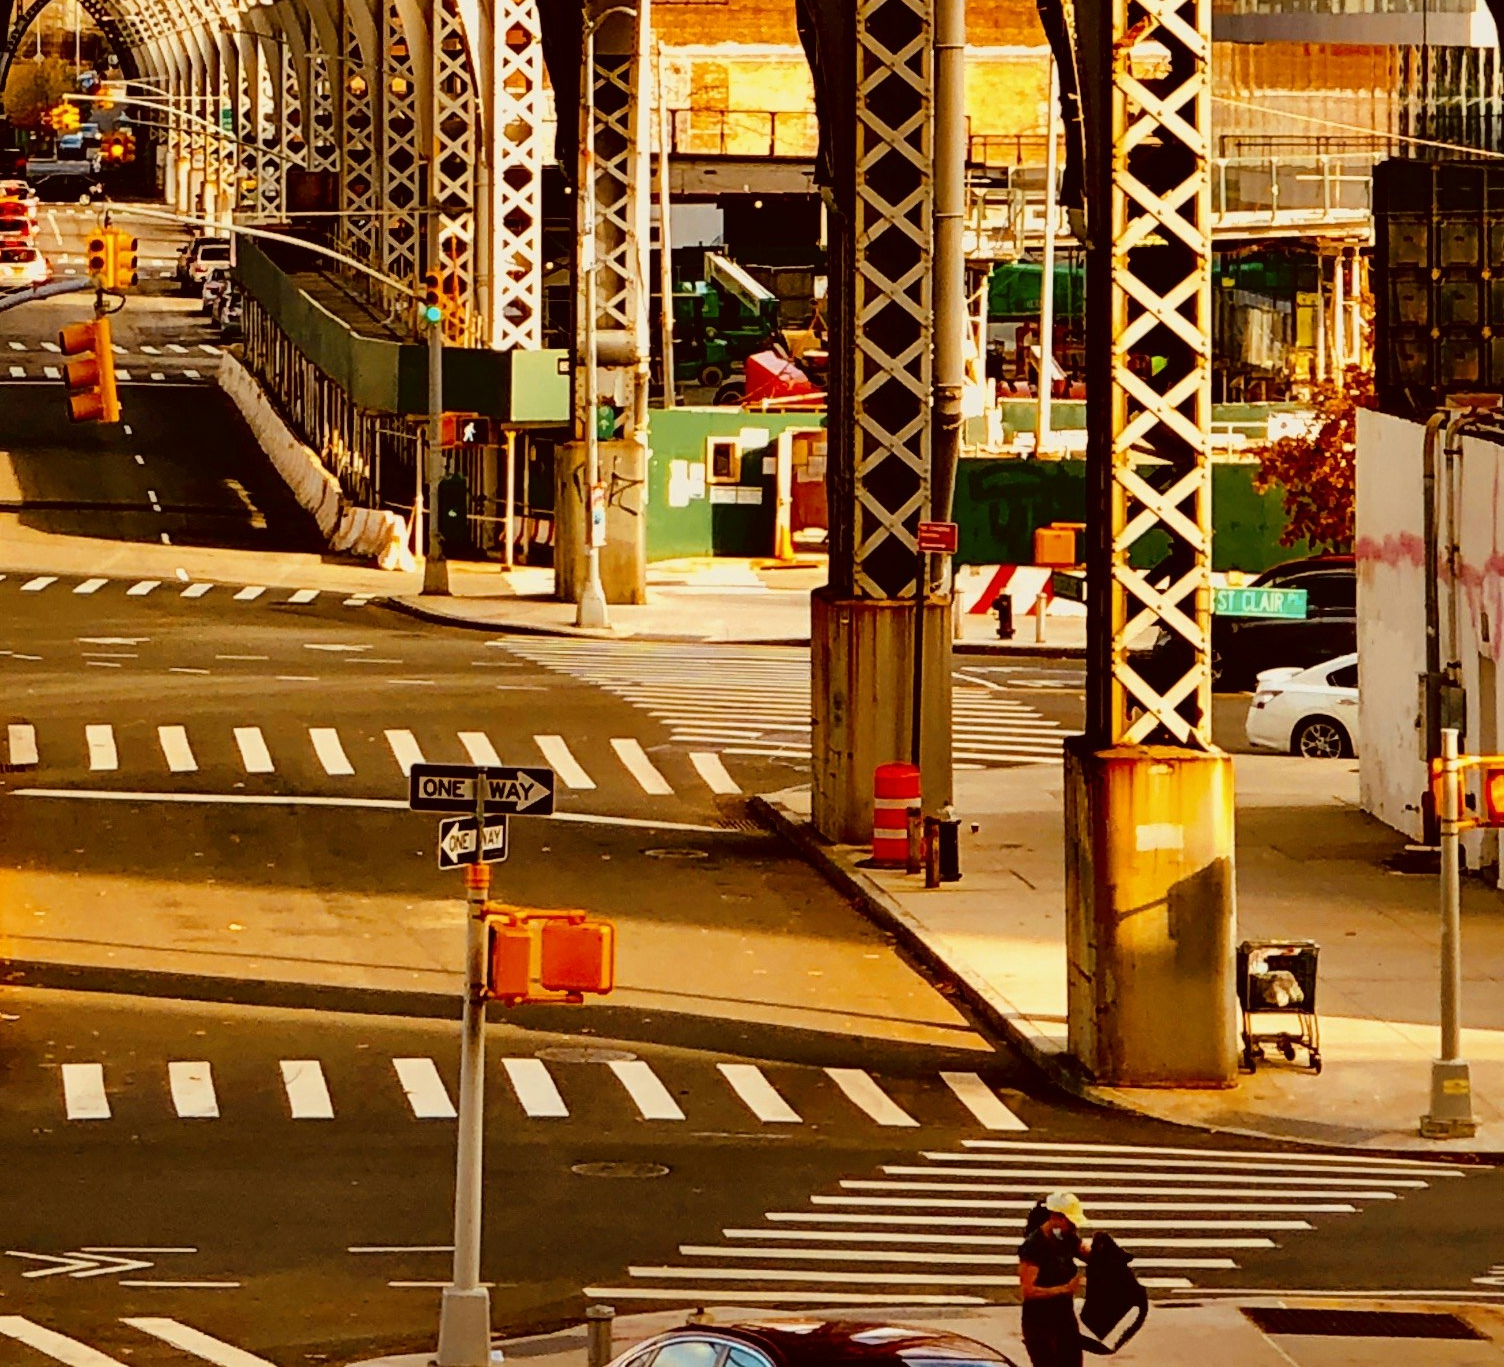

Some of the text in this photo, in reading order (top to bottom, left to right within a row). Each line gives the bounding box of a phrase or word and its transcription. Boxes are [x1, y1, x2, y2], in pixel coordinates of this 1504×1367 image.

[1217, 590, 1235, 612] ST
[1242, 591, 1284, 613] CLAIR
[423, 778, 535, 801] ONE WAY
[449, 833, 469, 852] ONE
